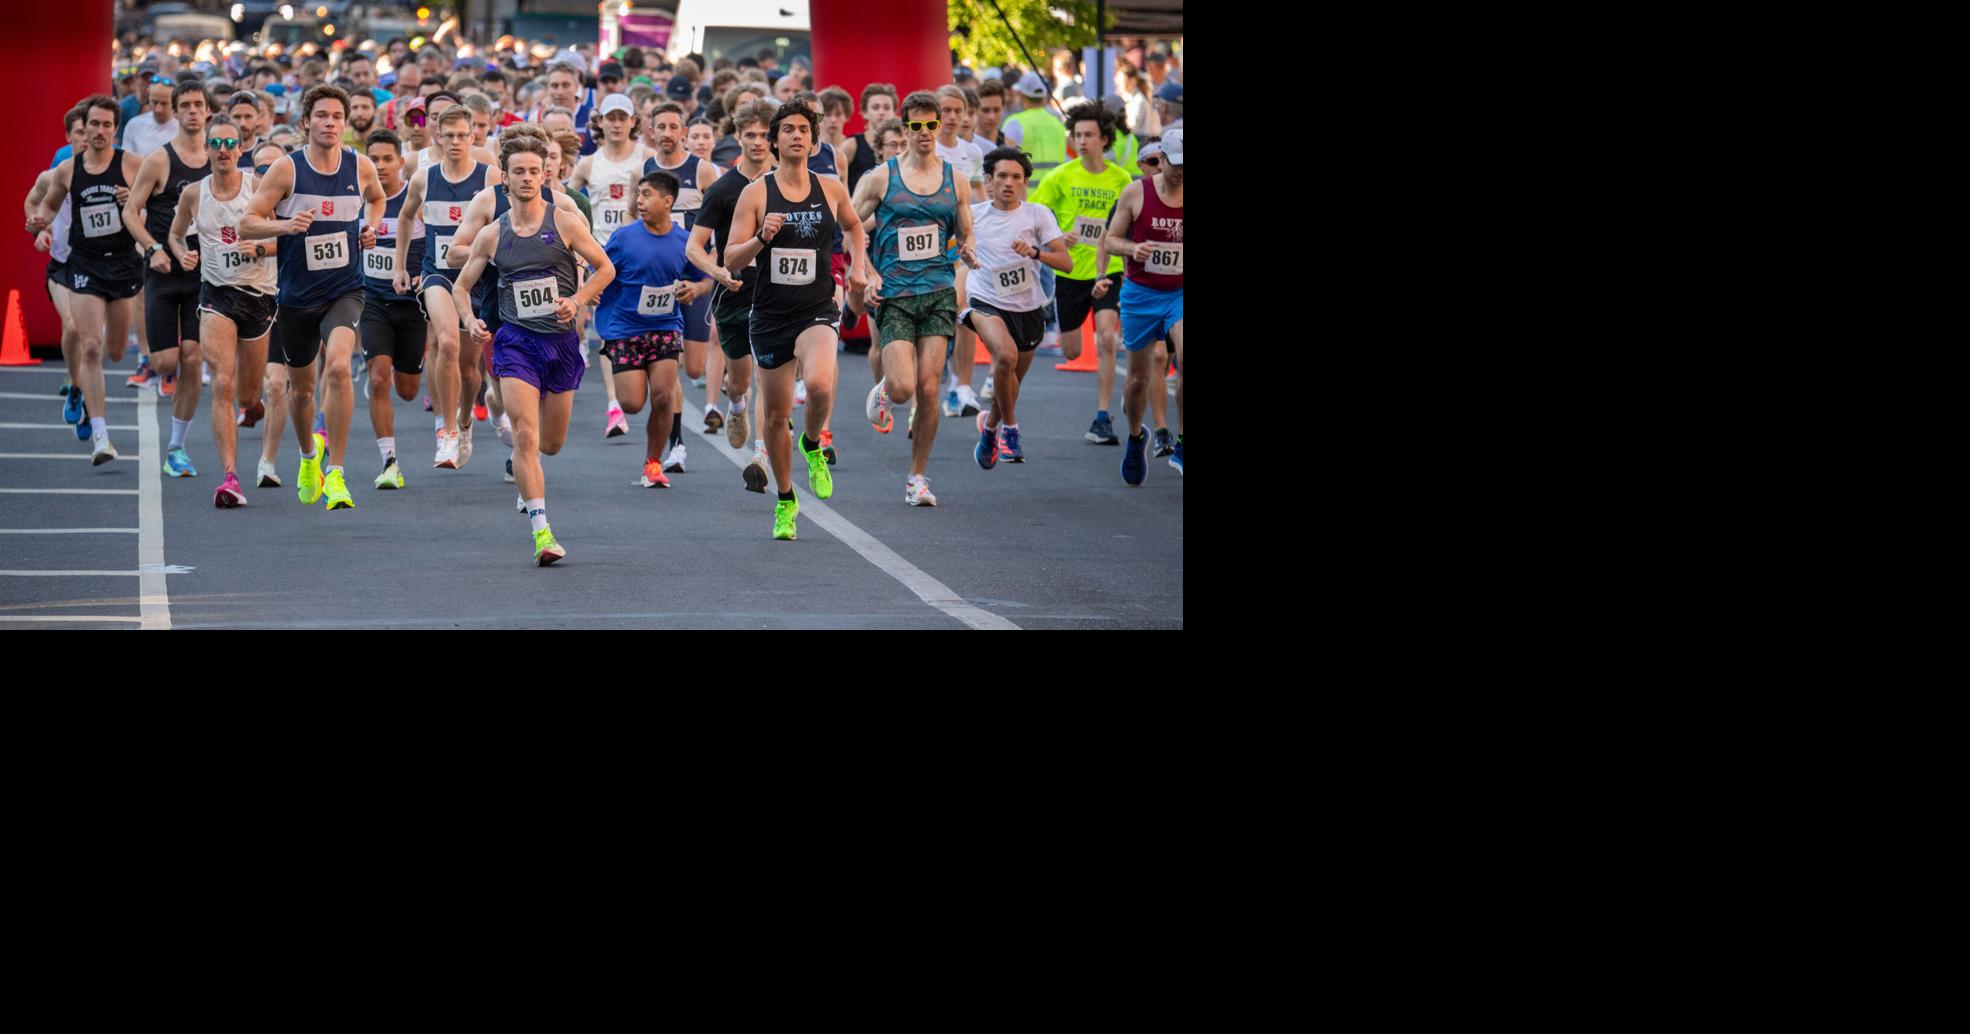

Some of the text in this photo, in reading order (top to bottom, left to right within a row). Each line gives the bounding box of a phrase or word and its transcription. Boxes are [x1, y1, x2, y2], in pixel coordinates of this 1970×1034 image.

[1071, 186, 1117, 200] TOWNSHIP
[1079, 198, 1107, 209] TRACK
[88, 211, 111, 228] 137
[784, 211, 823, 222] OUTES
[1080, 223, 1103, 239] 180
[313, 241, 342, 260] 531
[906, 233, 932, 251] 897
[367, 253, 393, 271] 690
[779, 257, 808, 275] 874
[1152, 249, 1180, 266] 867
[1000, 266, 1026, 287] 837
[520, 287, 553, 308] 504
[646, 293, 671, 308] 312
